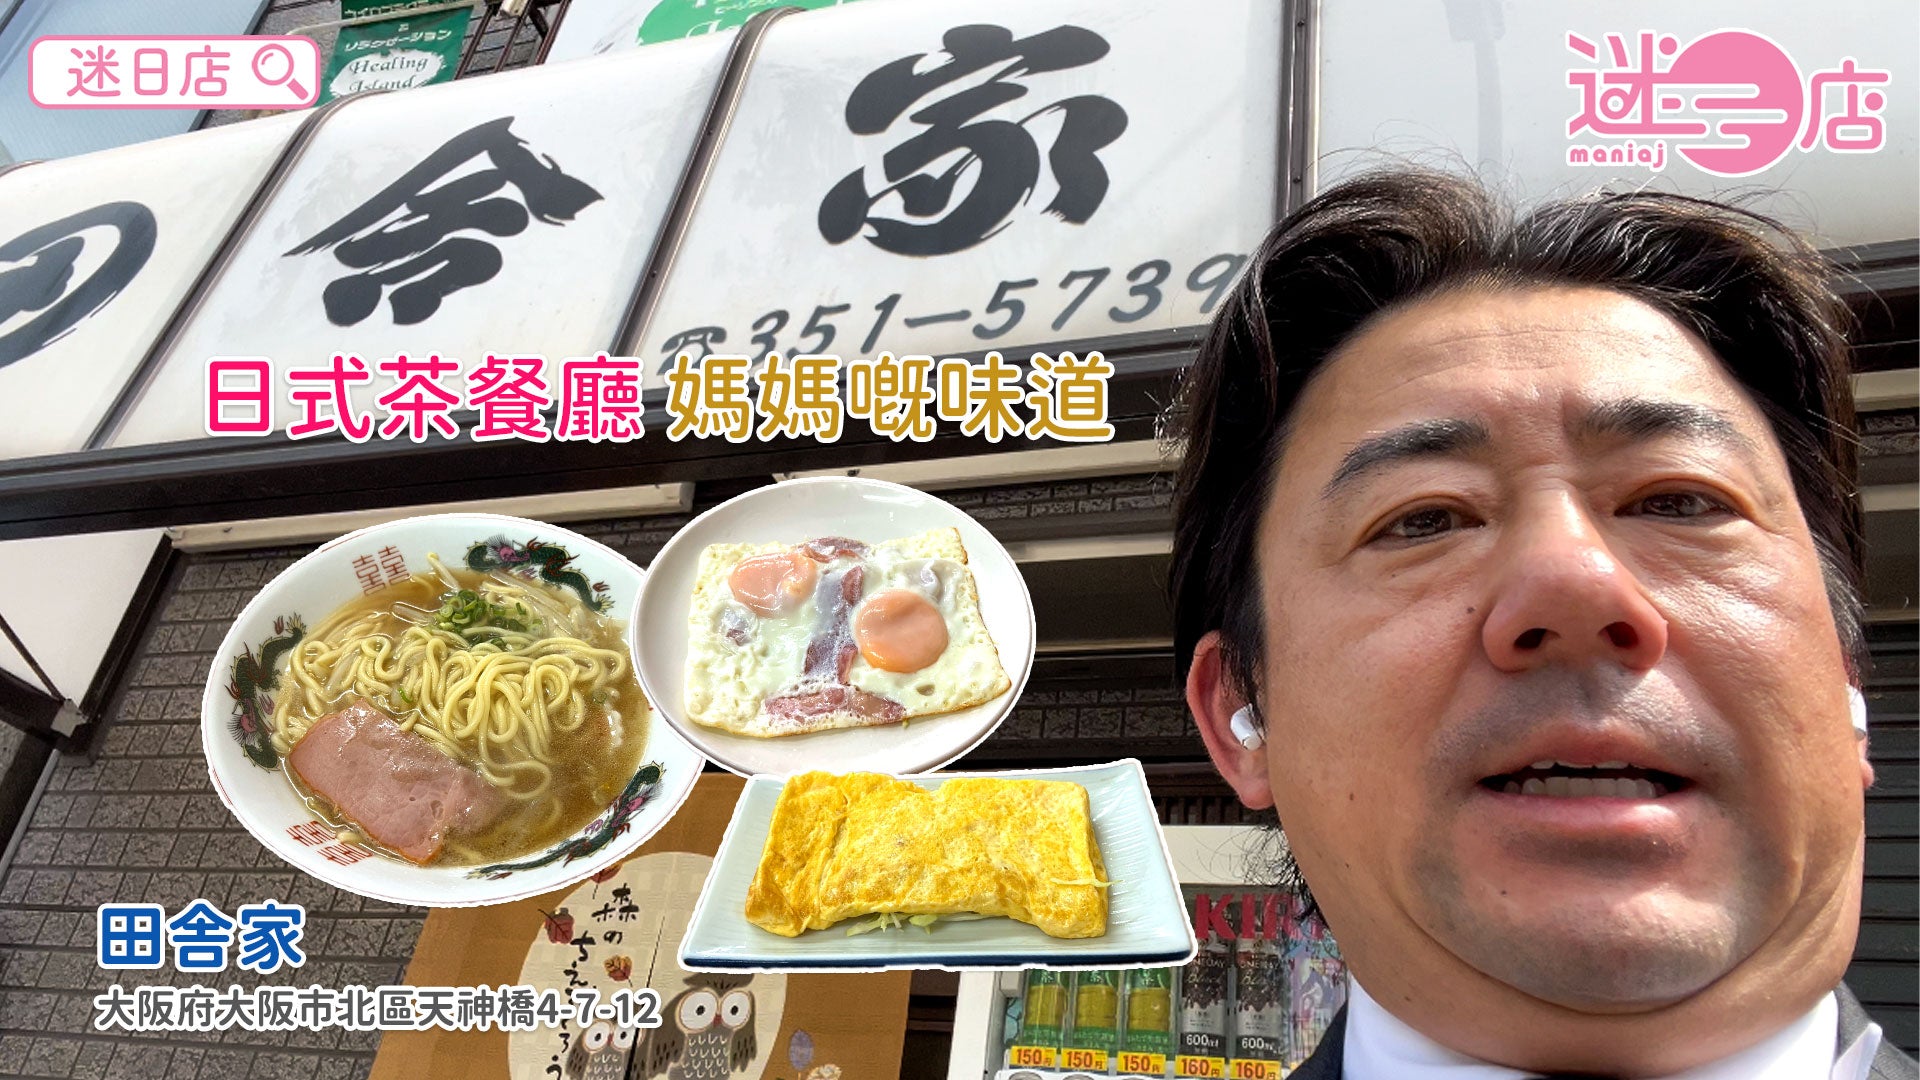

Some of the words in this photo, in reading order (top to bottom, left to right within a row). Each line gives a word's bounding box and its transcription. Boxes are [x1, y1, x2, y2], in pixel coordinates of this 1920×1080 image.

[351, 57, 429, 74] Healing
[350, 76, 416, 93] Island
[591, 883, 640, 944] 森の
